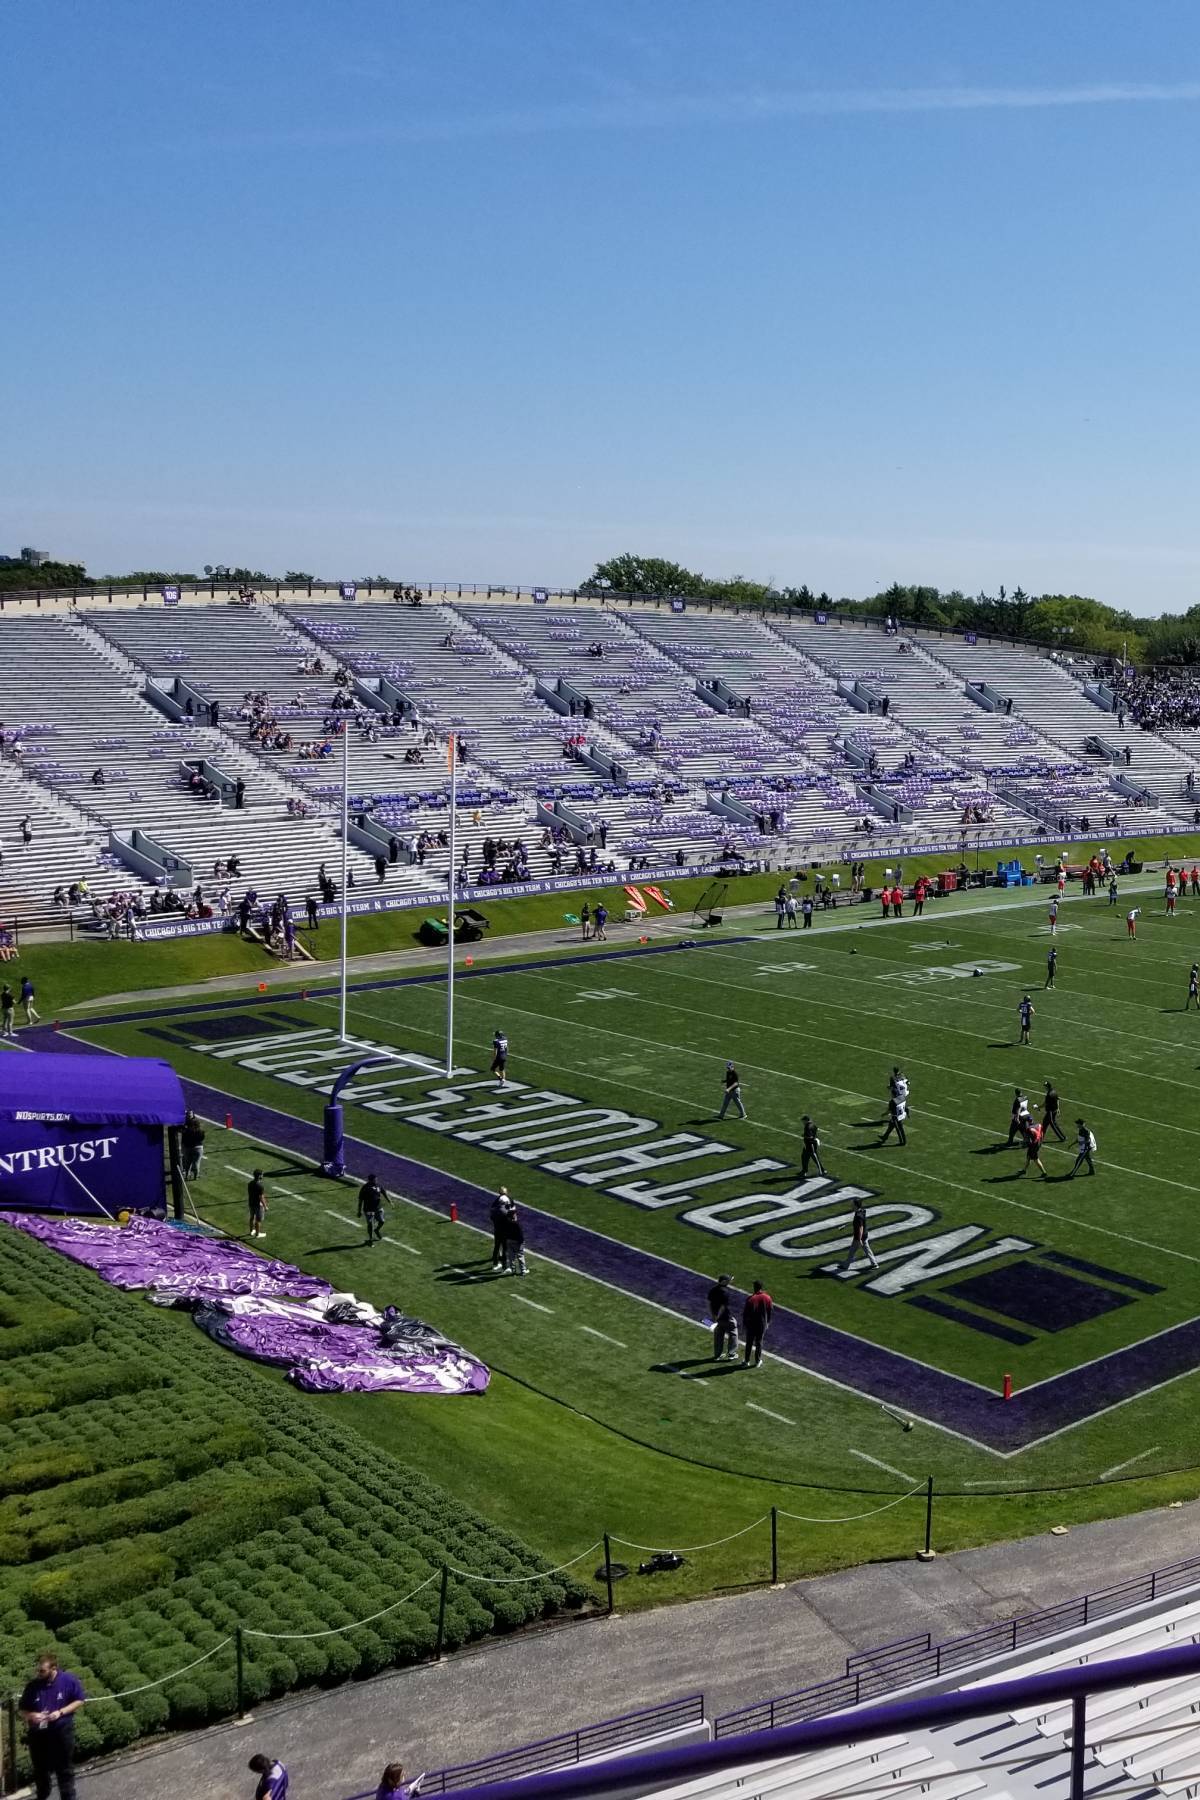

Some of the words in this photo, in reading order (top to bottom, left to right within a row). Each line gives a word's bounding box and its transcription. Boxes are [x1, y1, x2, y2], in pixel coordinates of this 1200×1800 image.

[165, 591, 177, 600] 106
[555, 878, 582, 888] CHICAGO'S
[582, 877, 592, 886] BIG
[592, 876, 602, 885] TEN
[602, 875, 617, 883] TEAM
[630, 871, 656, 880] CHICAGO'S
[656, 870, 665, 878] BIG
[473, 887, 502, 897] CHICAGO'S
[503, 887, 512, 895] BIG
[513, 886, 525, 894] TEN
[525, 884, 540, 892] TEAM
[386, 897, 416, 908] CHICAGO'S
[429, 895, 440, 903] TEN
[441, 893, 459, 901] TEM
[326, 906, 337, 915] BIG
[351, 903, 370, 912] TEAM
[145, 925, 183, 938] CHICAGO'S
[183, 923, 196, 932] BIG
[197, 922, 211, 930] TEN
[187, 1027, 1042, 1296] NORTHWESTERN
